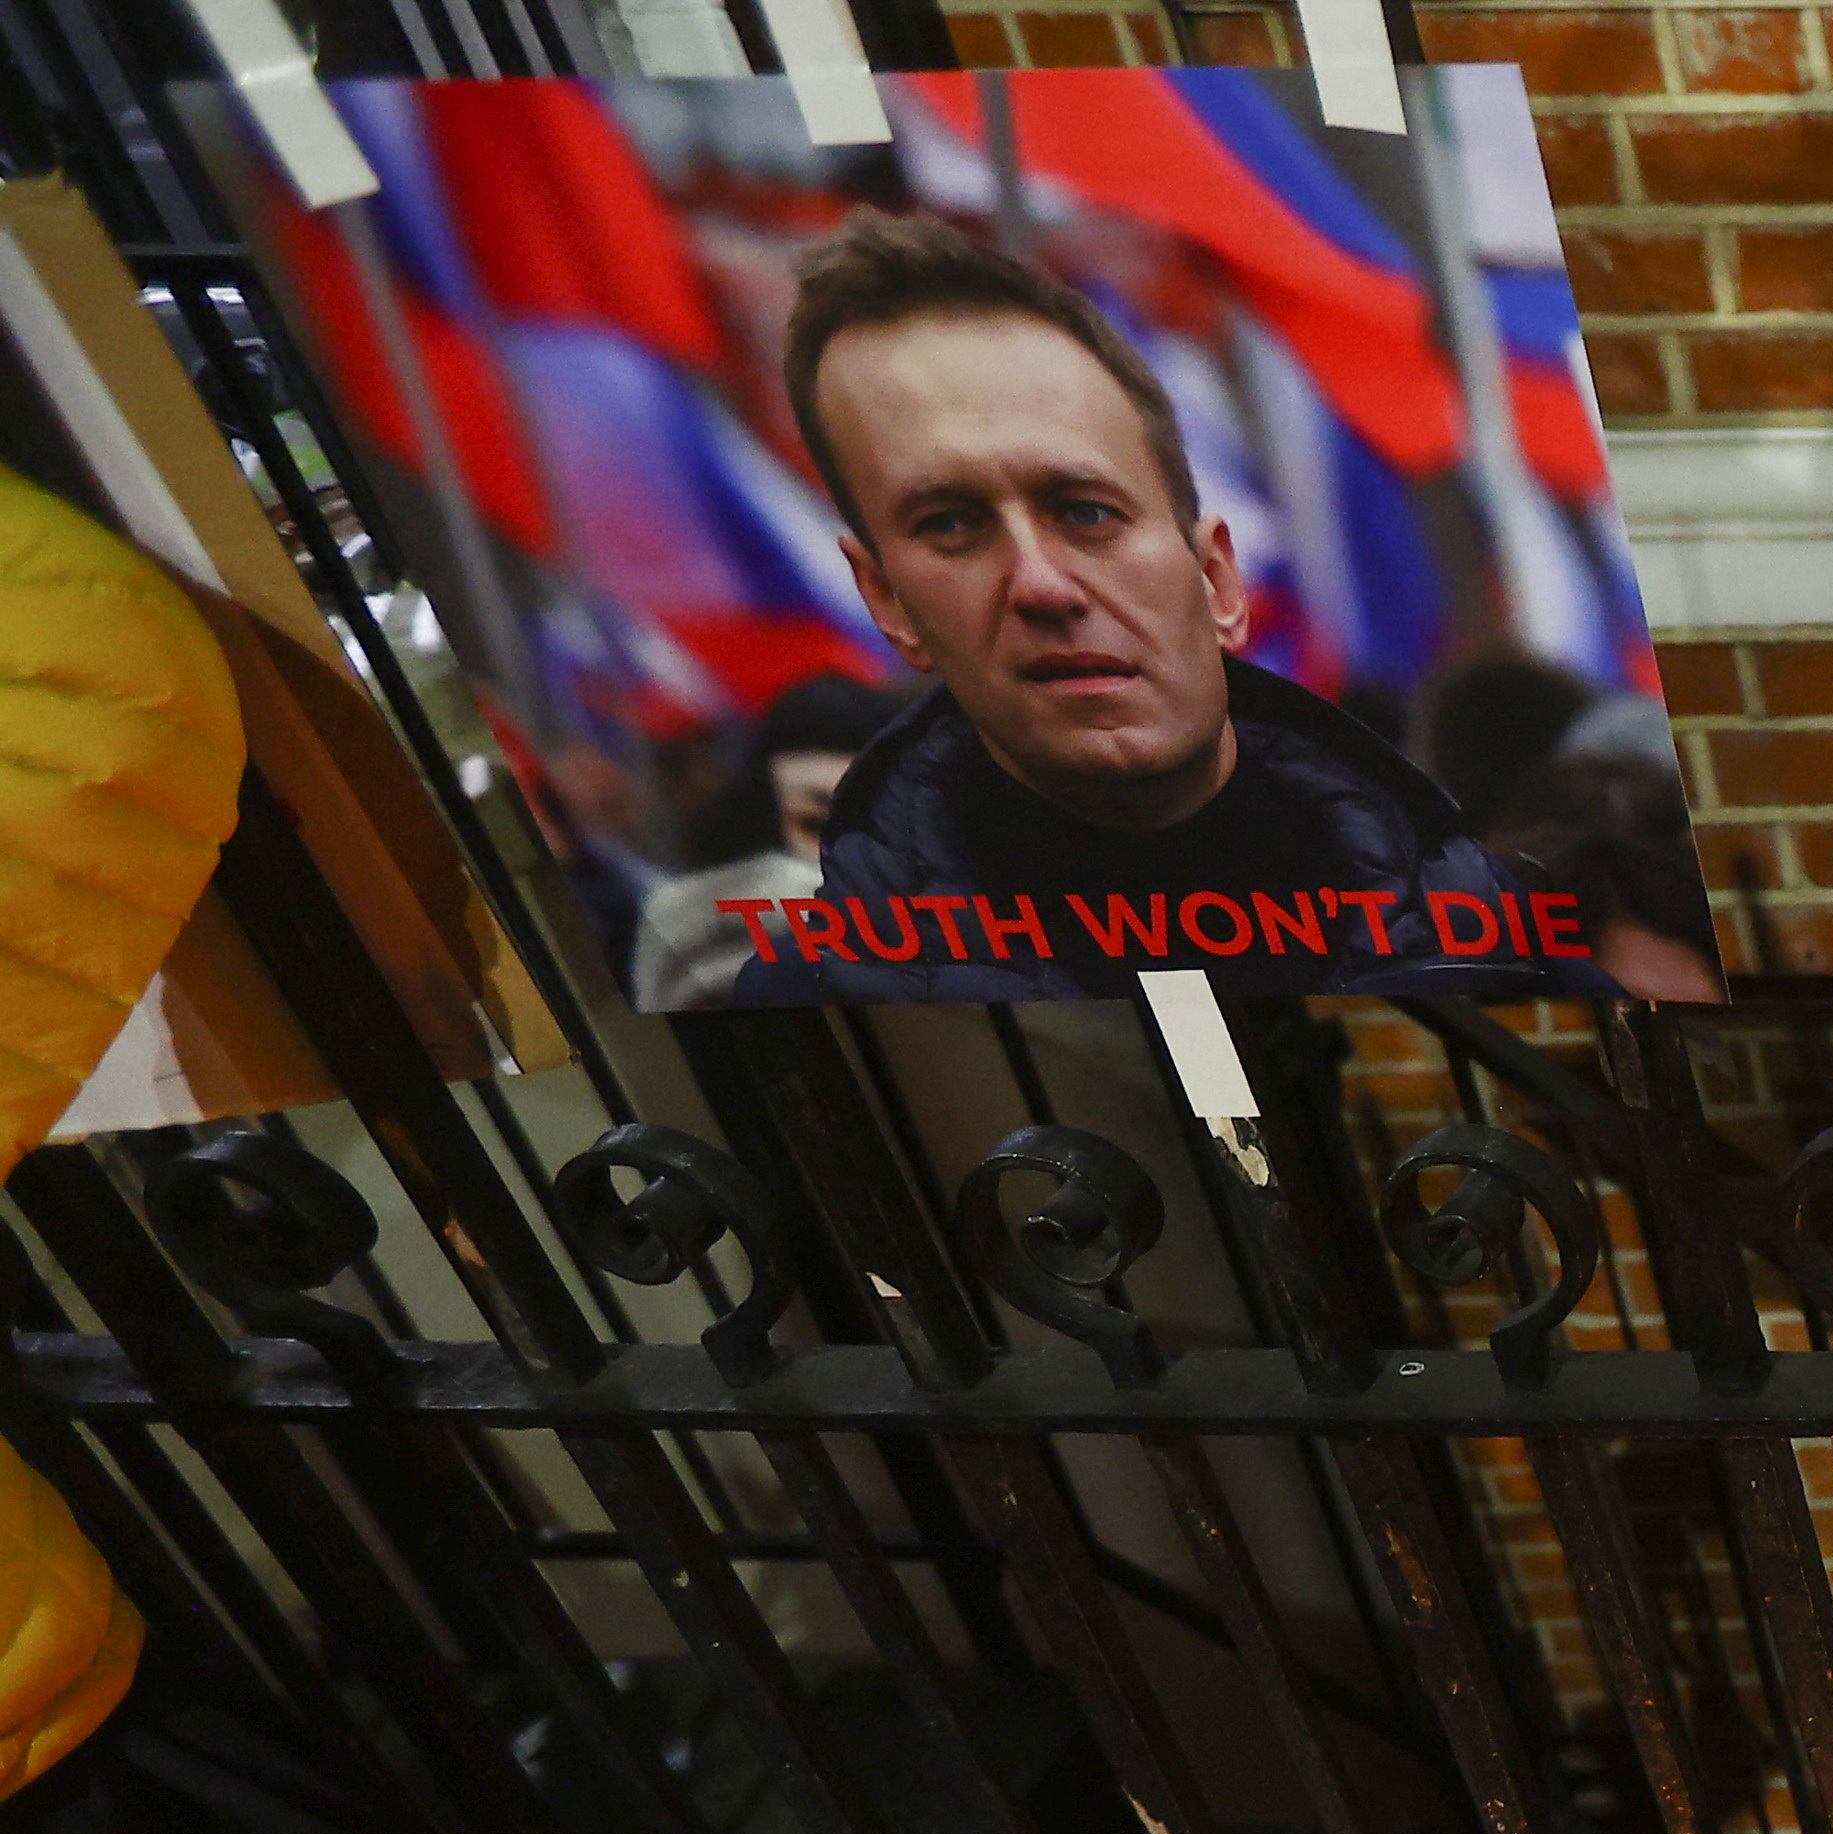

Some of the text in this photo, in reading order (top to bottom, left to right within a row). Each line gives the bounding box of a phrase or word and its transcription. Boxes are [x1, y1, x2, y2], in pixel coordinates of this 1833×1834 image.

[715, 889, 1593, 963] TRUTH WON'T DIE
